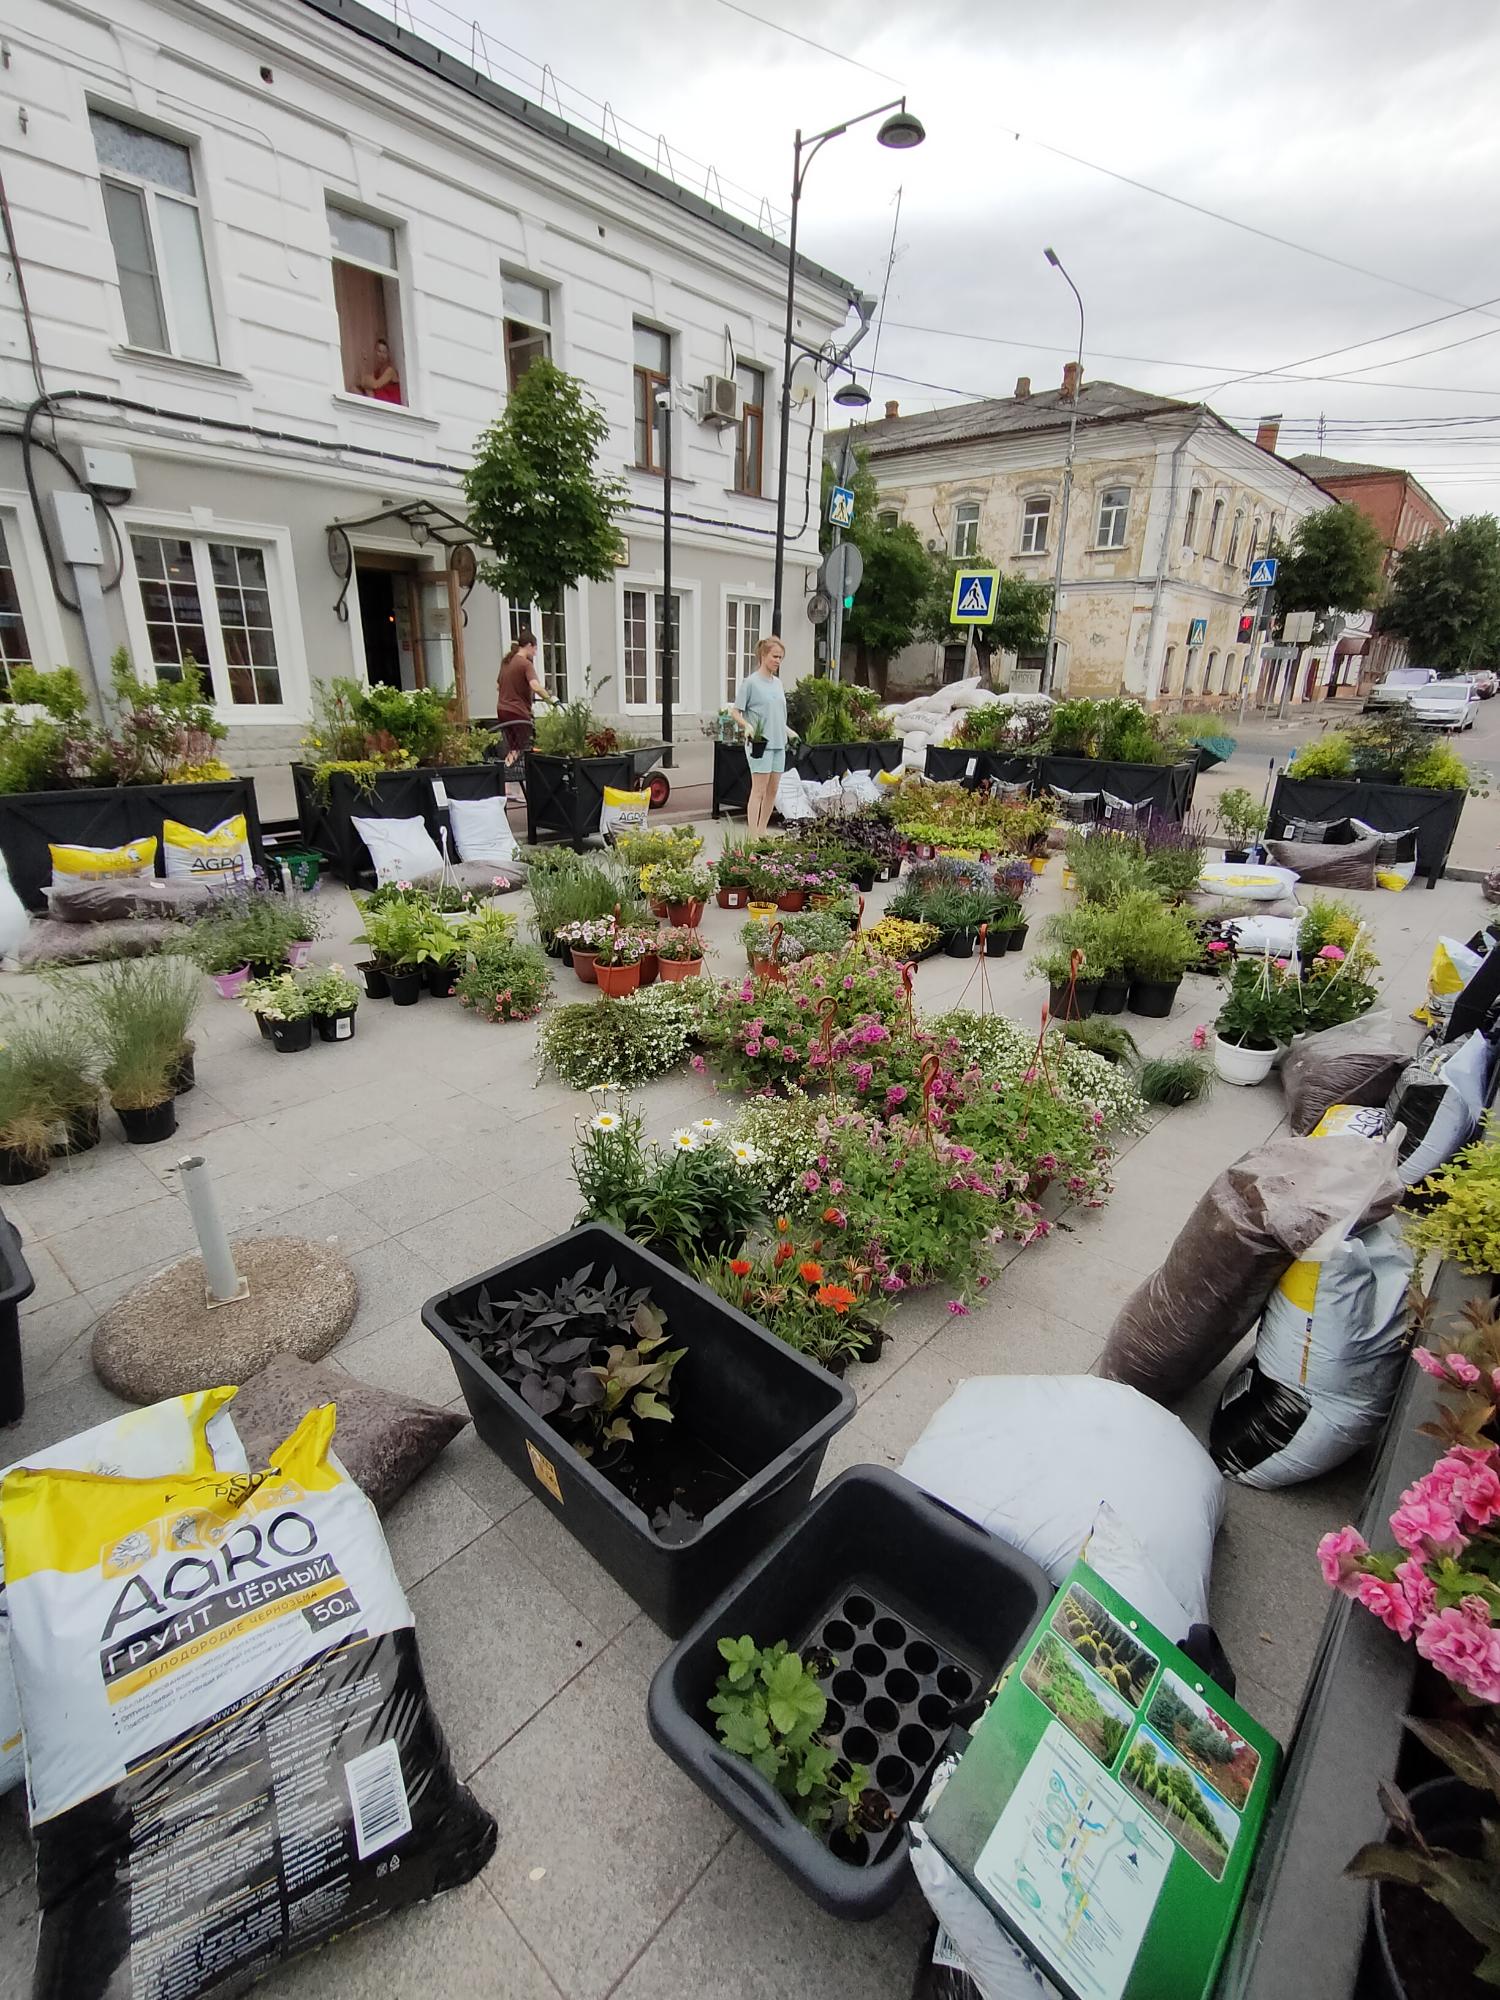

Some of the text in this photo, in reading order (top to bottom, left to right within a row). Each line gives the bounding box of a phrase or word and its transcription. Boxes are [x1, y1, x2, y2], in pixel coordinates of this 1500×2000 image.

[107, 1604, 213, 1675] ГРУНТ
[225, 1558, 332, 1609] ЧЁРНЫЙ
[312, 1598, 355, 1623] 50л
[148, 1622, 245, 1679] ПЛОДОРОДИЕ
